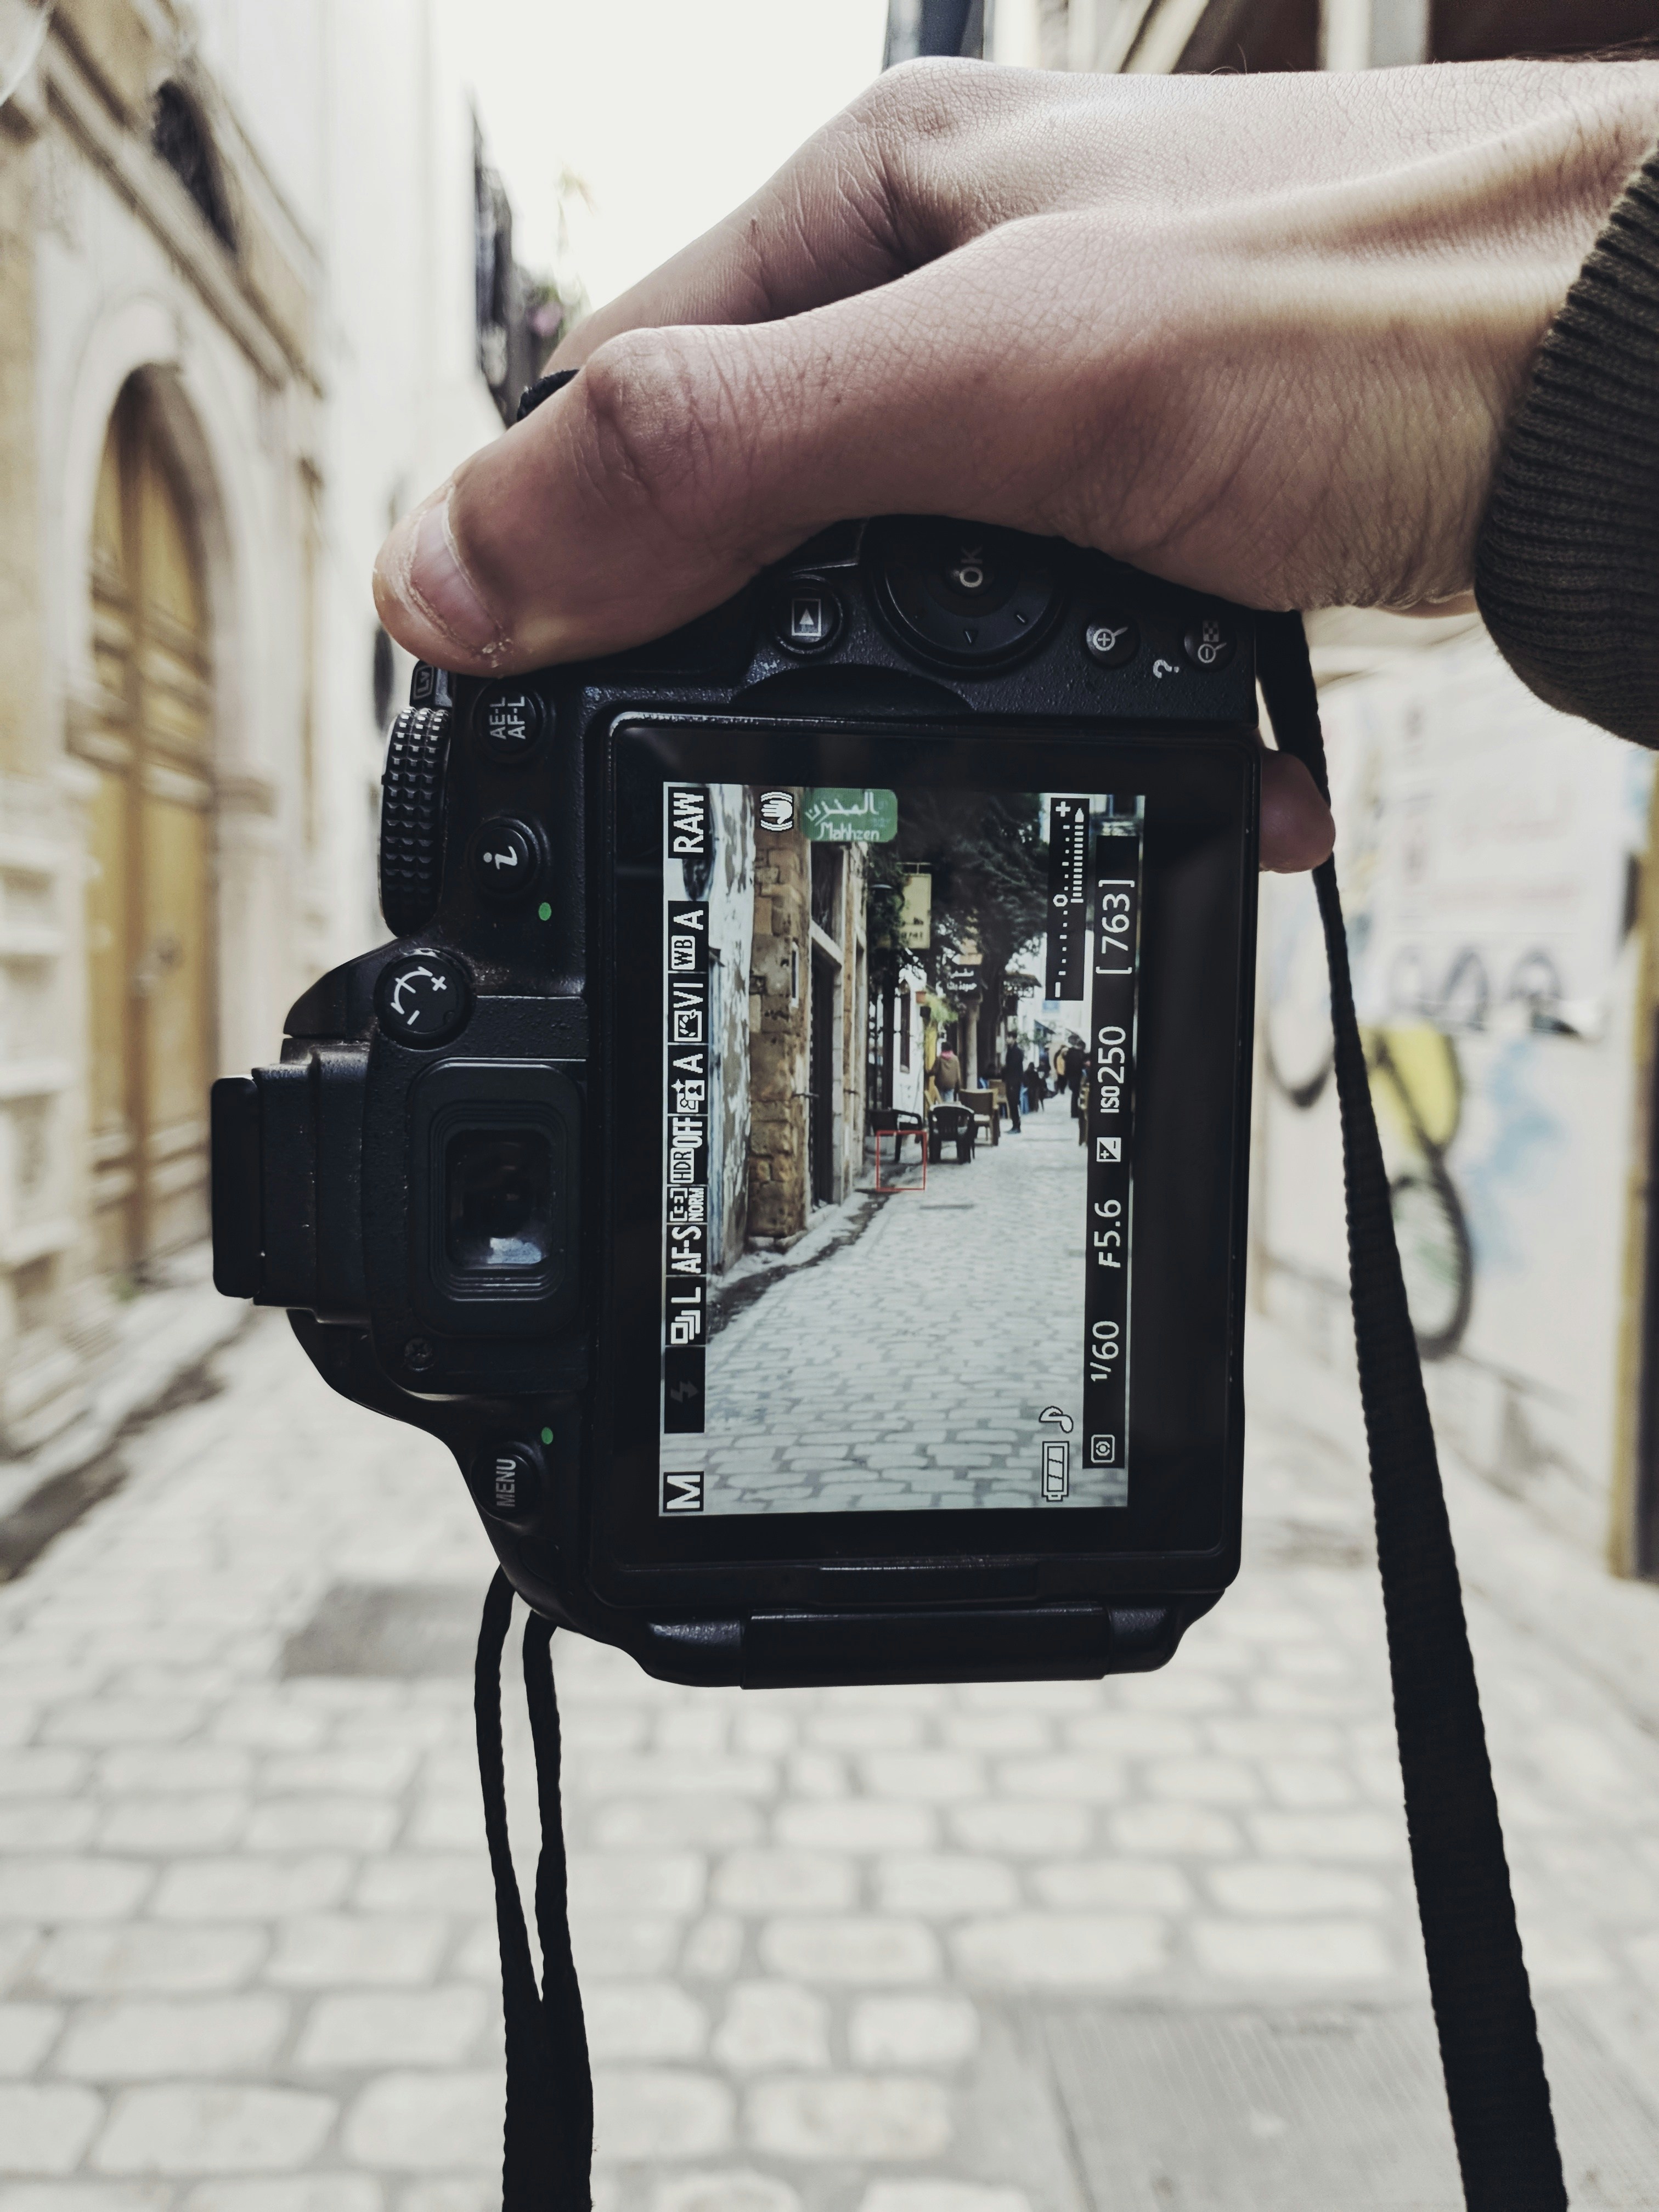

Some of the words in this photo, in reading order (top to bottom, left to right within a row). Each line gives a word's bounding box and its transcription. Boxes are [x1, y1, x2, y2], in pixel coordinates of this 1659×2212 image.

[959, 544, 983, 588] OK
[489, 696, 507, 740] AE-L
[507, 696, 526, 740] AF-L
[673, 792, 704, 853] RAW
[673, 910, 704, 930] A
[674, 939, 693, 966] WB
[673, 983, 704, 1008] VI
[673, 1053, 703, 1074] A
[673, 1117, 703, 1149] OFF
[673, 1150, 692, 1181] HDR
[688, 1187, 704, 1222] NORM
[670, 1225, 702, 1274] AF-S
[1094, 1199, 1121, 1268] F5.6
[670, 1286, 701, 1303] L
[1089, 1320, 1120, 1382] 1/60
[495, 1458, 517, 1507] MENU
[666, 1474, 701, 1510] M
